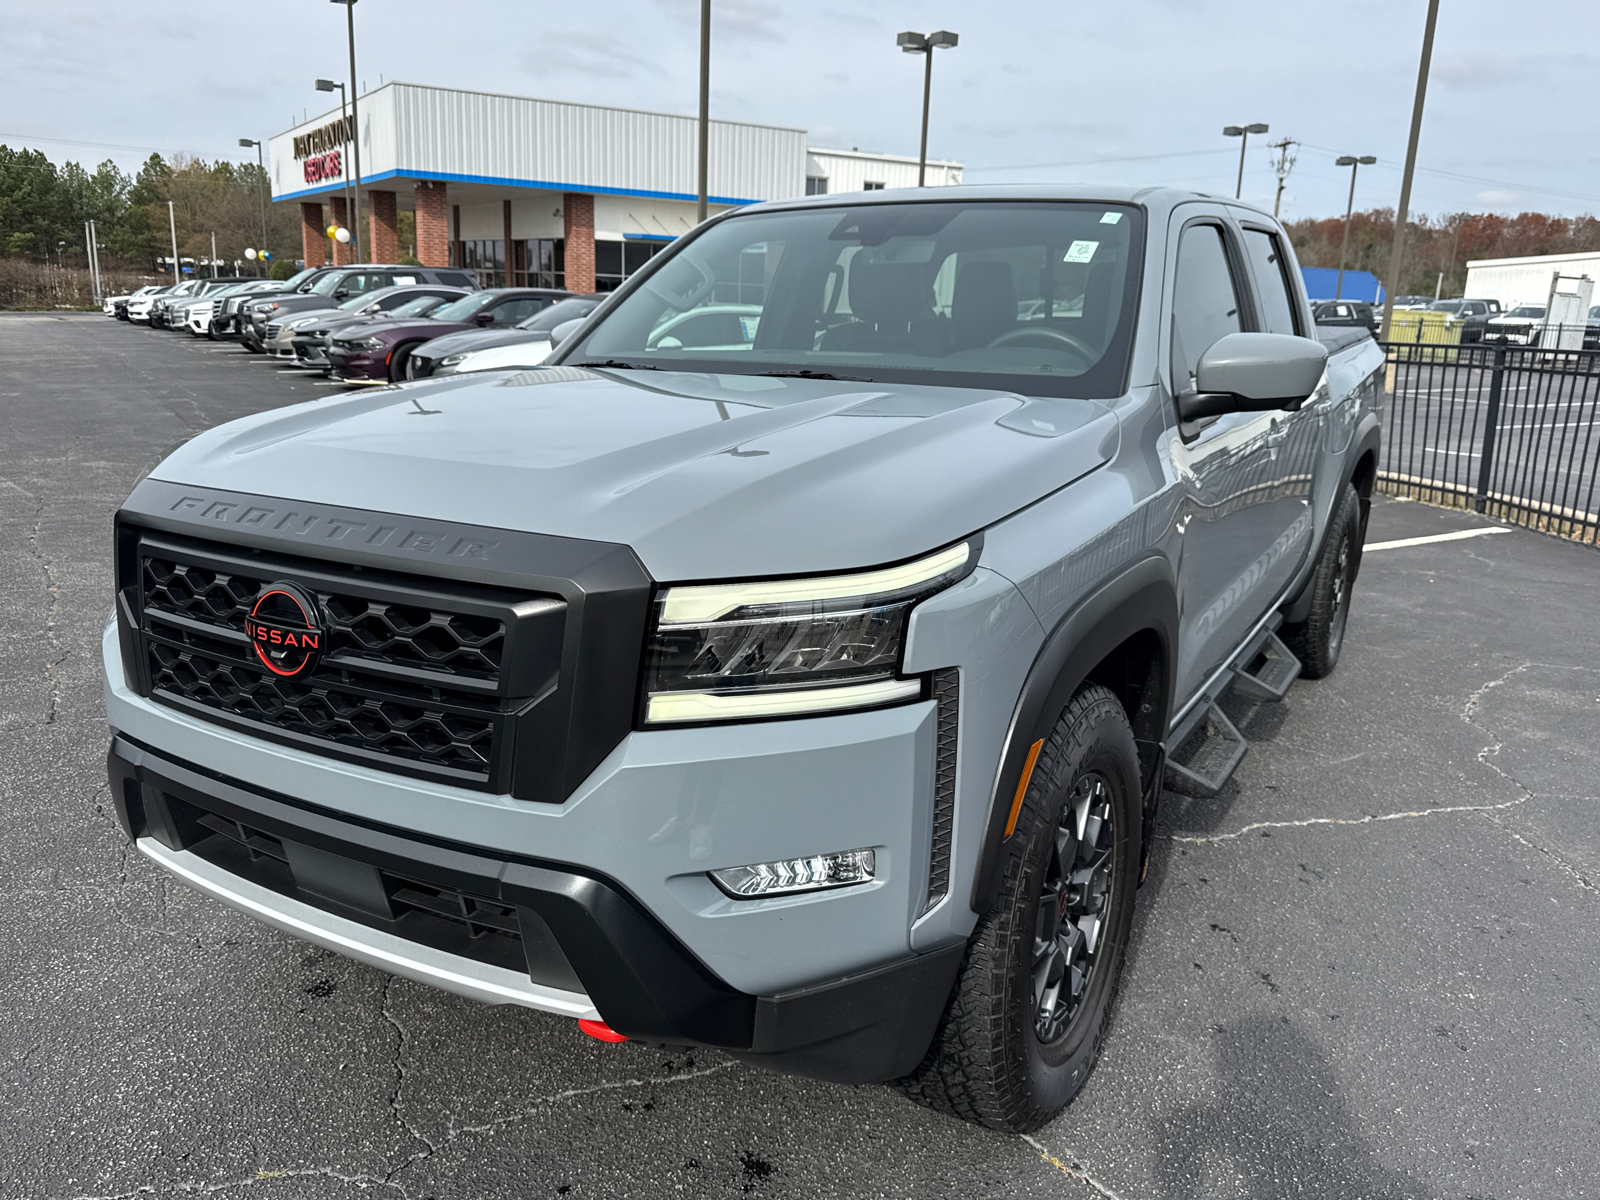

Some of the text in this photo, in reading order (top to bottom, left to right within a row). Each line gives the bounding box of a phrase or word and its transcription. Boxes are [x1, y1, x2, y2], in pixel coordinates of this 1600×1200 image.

[303, 150, 342, 183] USED CARS
[169, 496, 500, 561] FRONTIER
[245, 620, 318, 649] NISSAN
